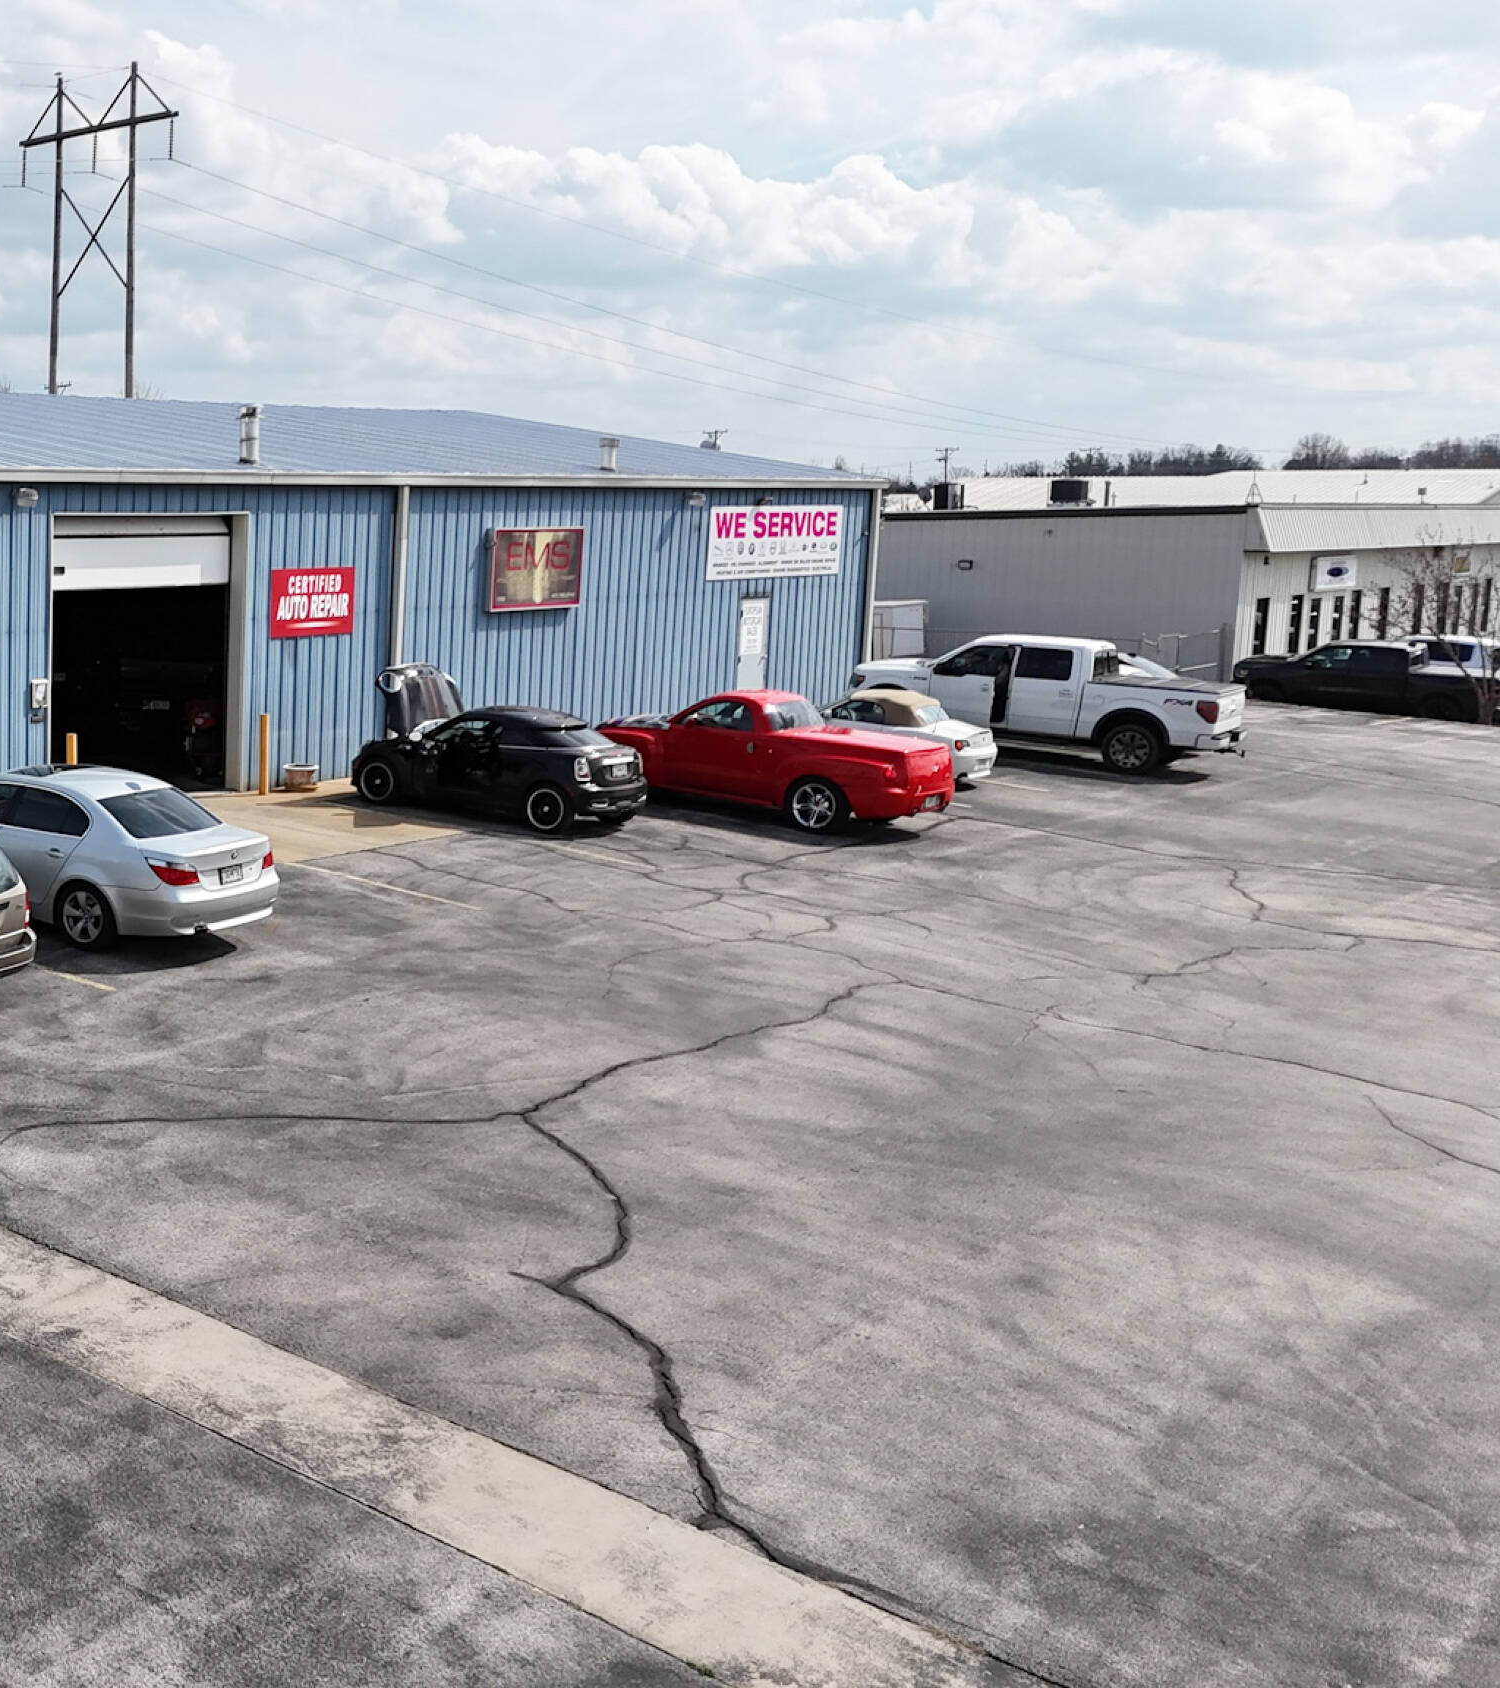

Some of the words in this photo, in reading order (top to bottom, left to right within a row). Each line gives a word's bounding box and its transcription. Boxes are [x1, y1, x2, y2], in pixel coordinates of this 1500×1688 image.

[716, 512, 747, 538] WE
[753, 511, 838, 538] SERVICE
[506, 540, 571, 571] EMS
[287, 574, 342, 595] CERTIFIED
[276, 595, 309, 620] AUTO
[309, 593, 349, 618] REPAIR
